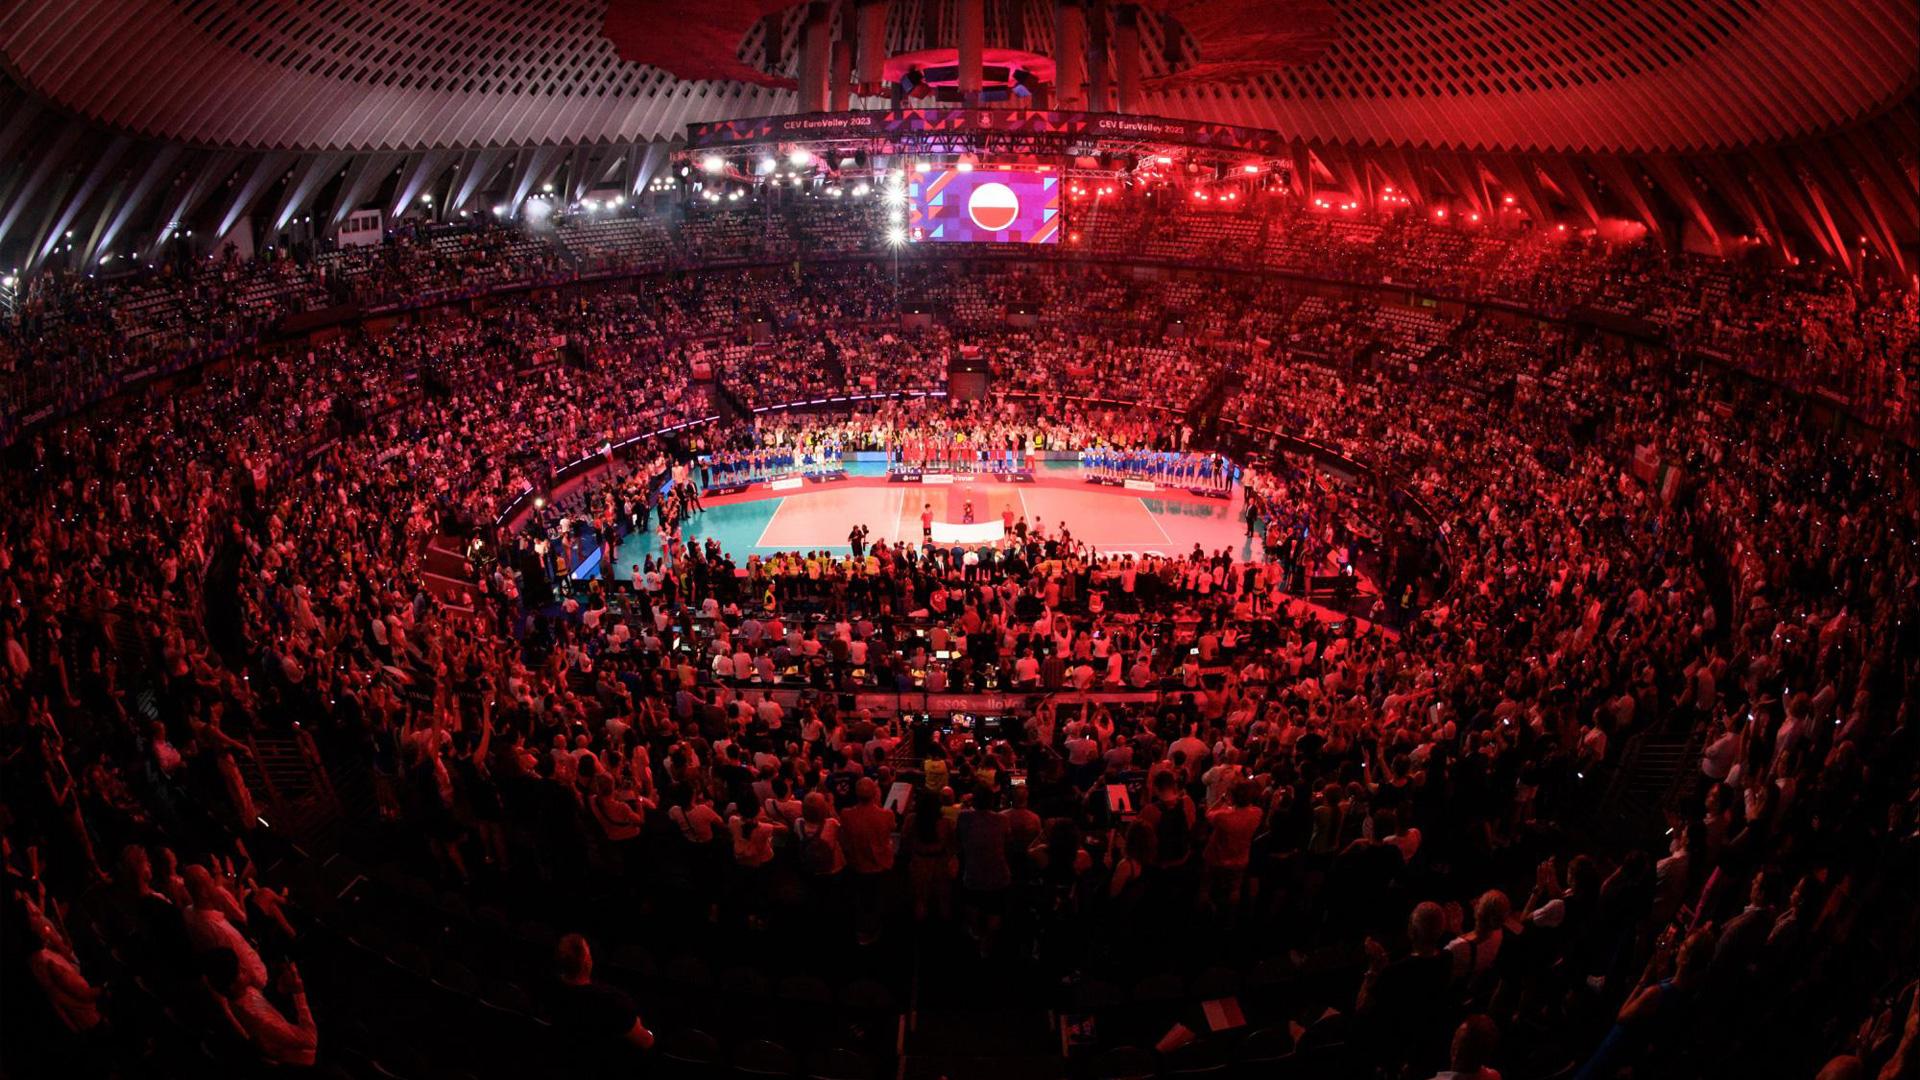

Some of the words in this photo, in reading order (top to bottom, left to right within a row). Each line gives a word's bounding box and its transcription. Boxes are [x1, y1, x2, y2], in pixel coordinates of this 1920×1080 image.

[783, 121, 802, 129] CEV
[803, 118, 848, 128] EuroVolley
[850, 117, 871, 126] 2023
[1099, 120, 1117, 129] CEV
[1118, 121, 1162, 133] EuroVolley
[1164, 125, 1185, 134] 2023
